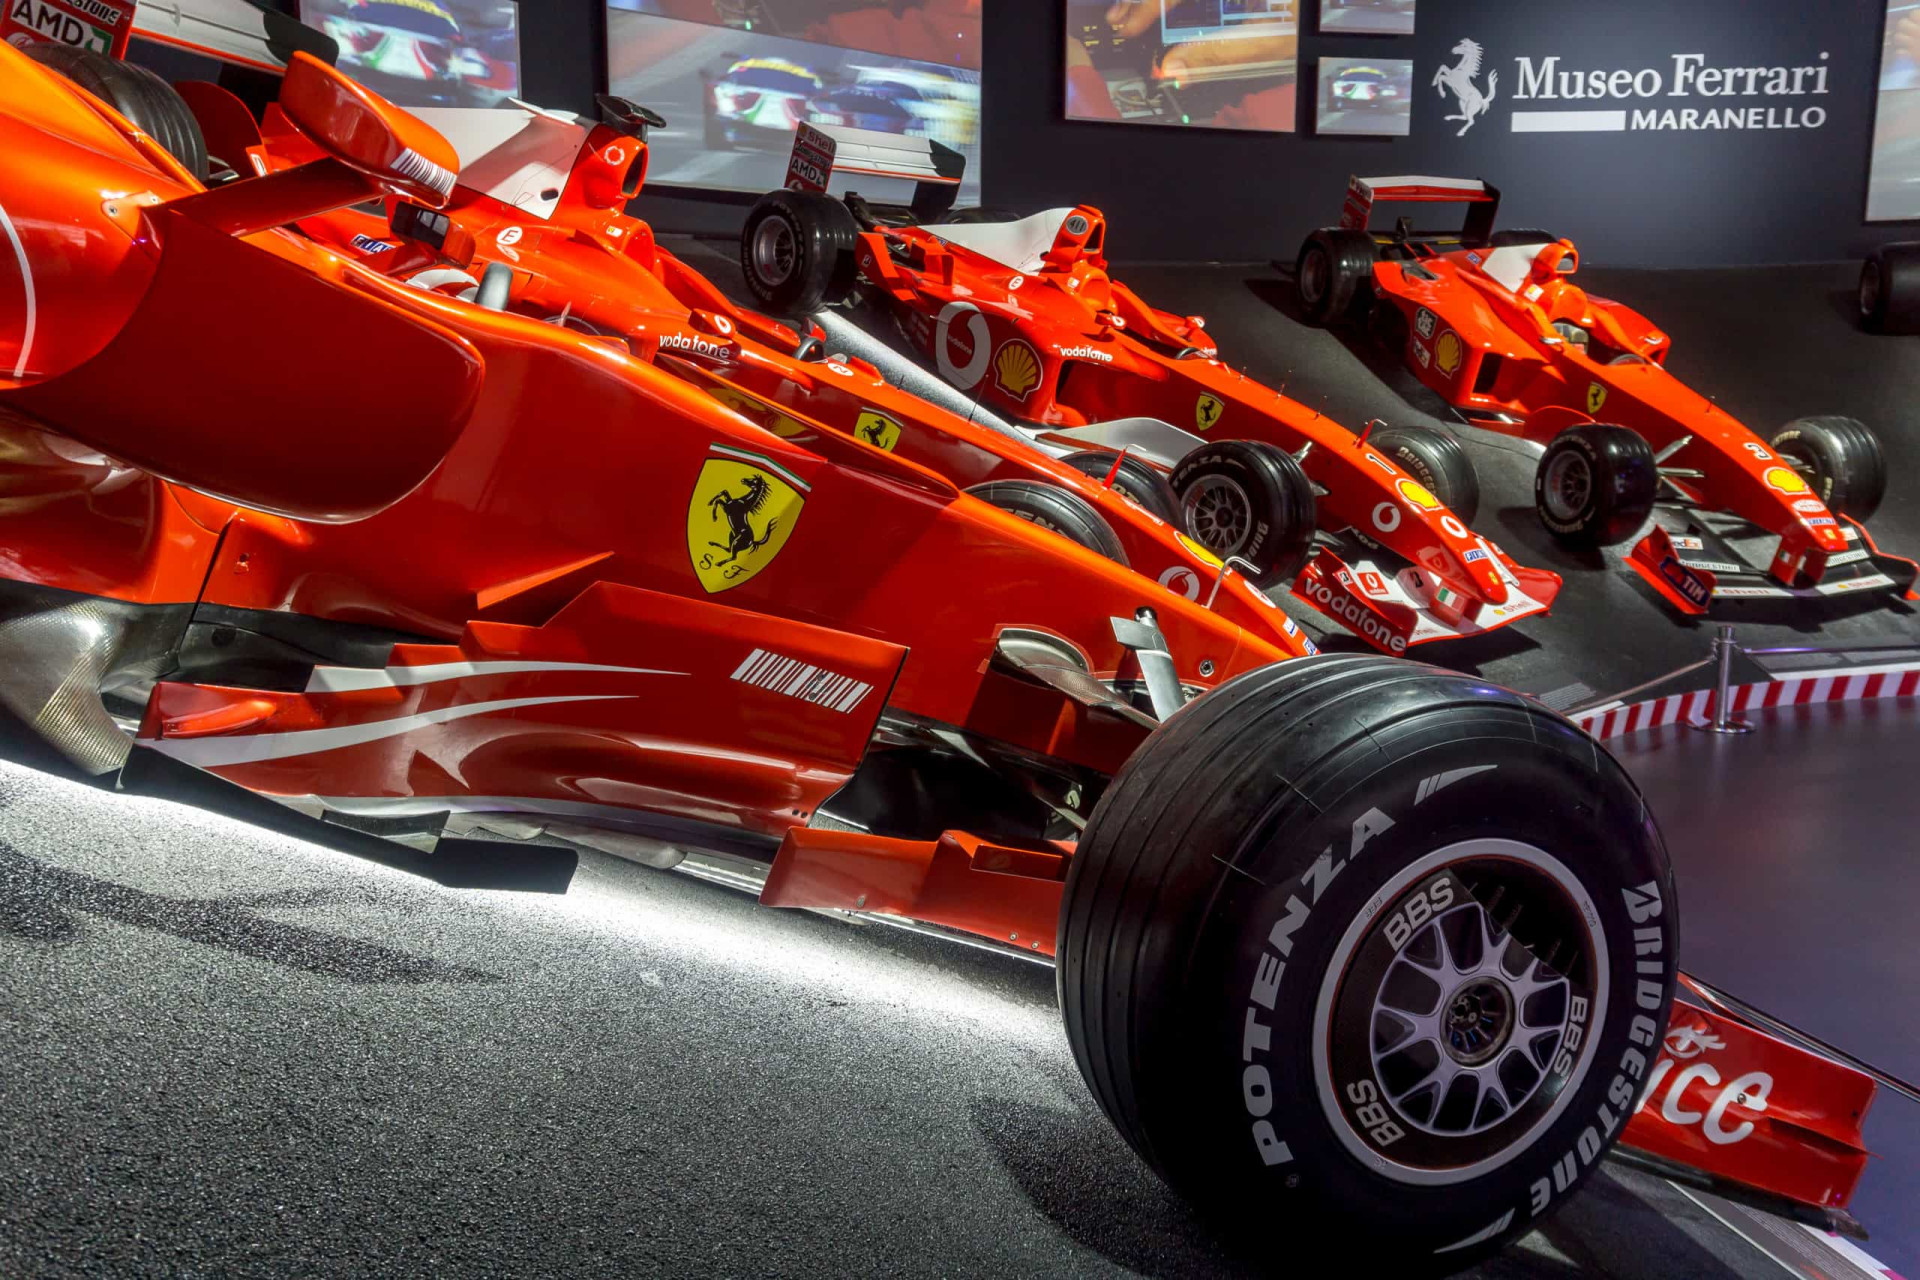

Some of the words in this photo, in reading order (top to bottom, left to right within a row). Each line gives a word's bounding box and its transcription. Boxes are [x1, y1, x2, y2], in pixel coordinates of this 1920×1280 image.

[12, 0, 84, 46] AMD
[1511, 56, 1662, 99] Museo
[1667, 51, 1830, 97] Ferrari
[1631, 106, 1827, 130] MARANELLO
[791, 159, 817, 181] AMD
[659, 332, 730, 358] vodafone
[1060, 345, 1113, 362] vodafone
[699, 553, 714, 571] S
[1683, 575, 1706, 601] TIM
[1304, 578, 1407, 652] vodafone
[1383, 877, 1455, 952] BBS
[1242, 806, 1397, 1167] POTENZA
[1530, 880, 1664, 1218] BRIDGESTONE
[1553, 995, 1588, 1078] BBS
[1347, 1078, 1406, 1147] BBS
